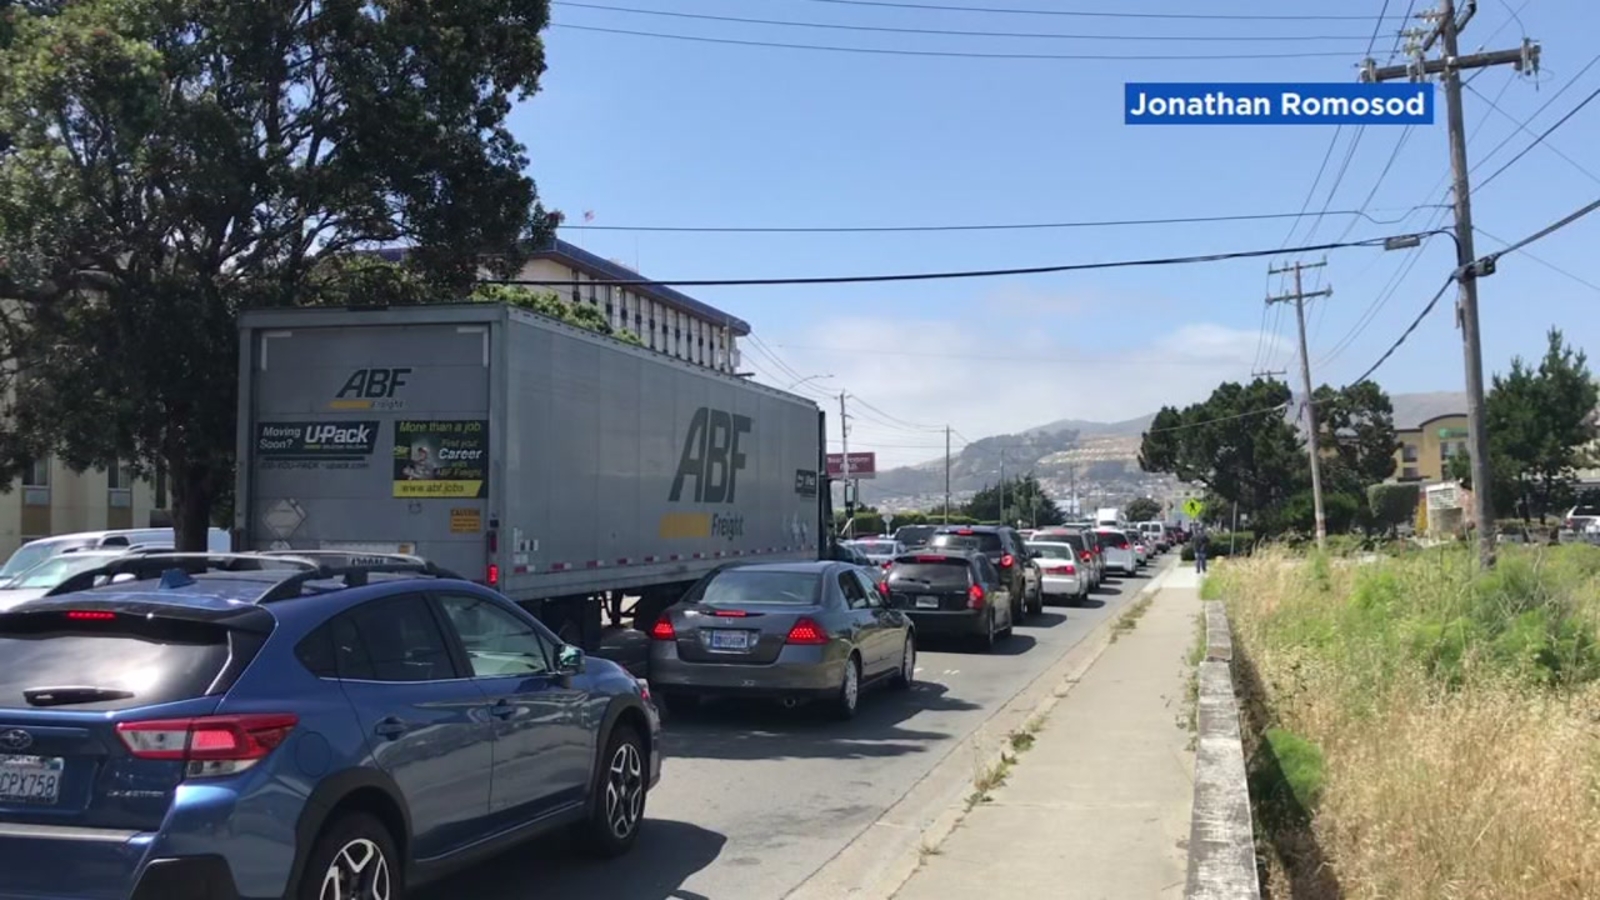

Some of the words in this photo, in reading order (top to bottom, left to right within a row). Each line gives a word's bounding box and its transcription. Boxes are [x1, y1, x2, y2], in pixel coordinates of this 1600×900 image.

[336, 368, 412, 398] ABF
[263, 426, 301, 439] Moving
[399, 421, 427, 433] More
[429, 421, 452, 432] than
[455, 423, 462, 432] a
[464, 421, 481, 434] job
[259, 439, 294, 450] Soon?
[438, 448, 482, 460] Career
[667, 407, 752, 503] ABF
[401, 483, 464, 494] www.abf.jobs
[711, 512, 744, 540] Freight
